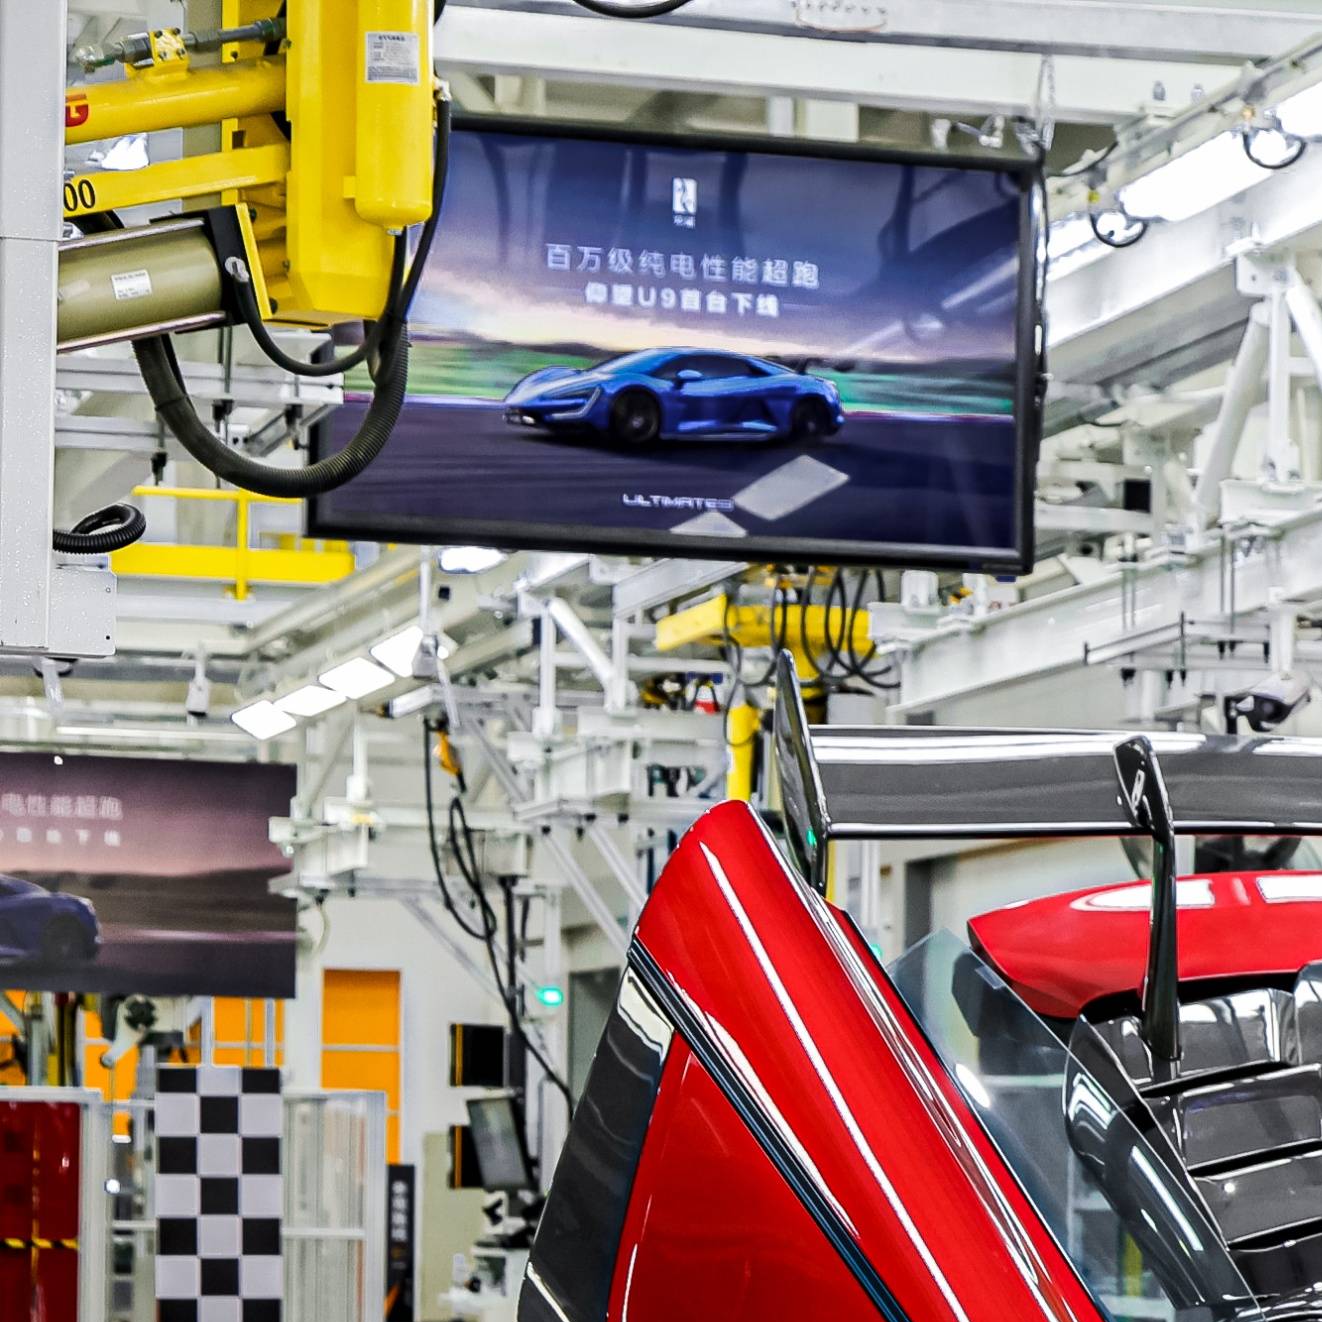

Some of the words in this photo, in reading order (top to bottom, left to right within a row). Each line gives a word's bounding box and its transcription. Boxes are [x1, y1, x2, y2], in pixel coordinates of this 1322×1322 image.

[546, 244, 820, 289] 百万级纯电性能超跑
